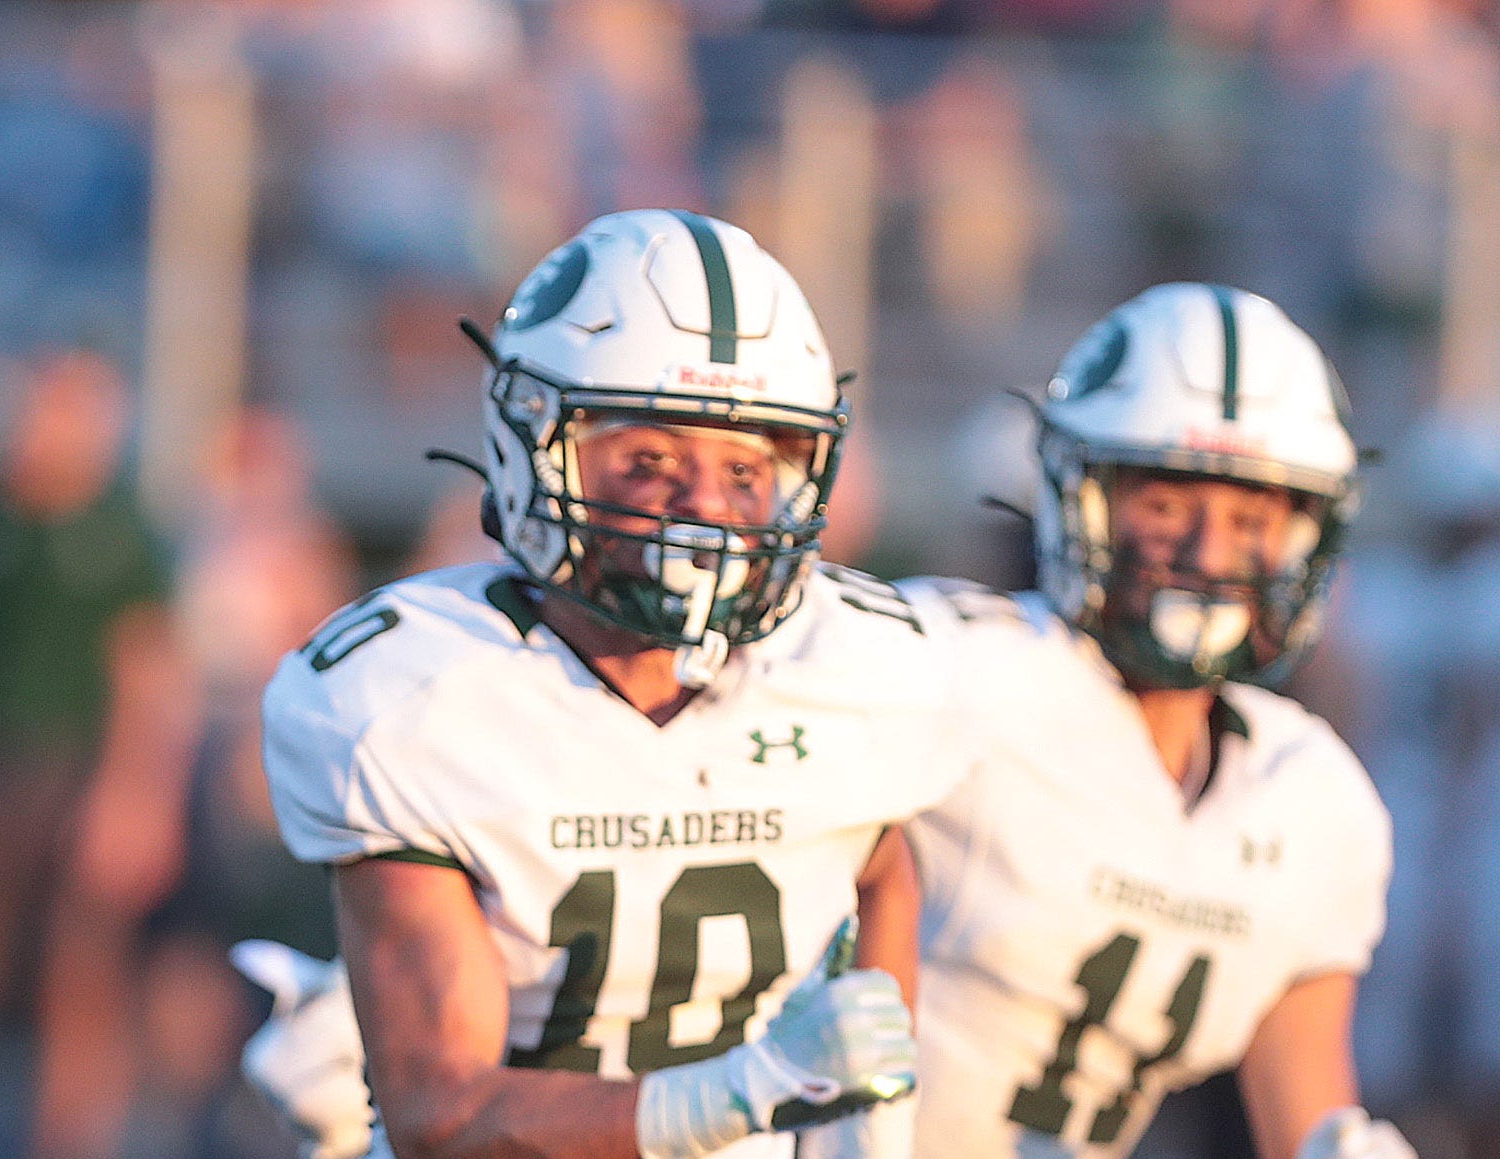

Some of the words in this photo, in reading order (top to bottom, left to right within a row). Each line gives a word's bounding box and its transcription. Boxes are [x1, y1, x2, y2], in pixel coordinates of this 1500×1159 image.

[551, 808, 783, 850] CRUSADERS
[506, 860, 787, 1073] 10
[1007, 933, 1211, 1144] 11
